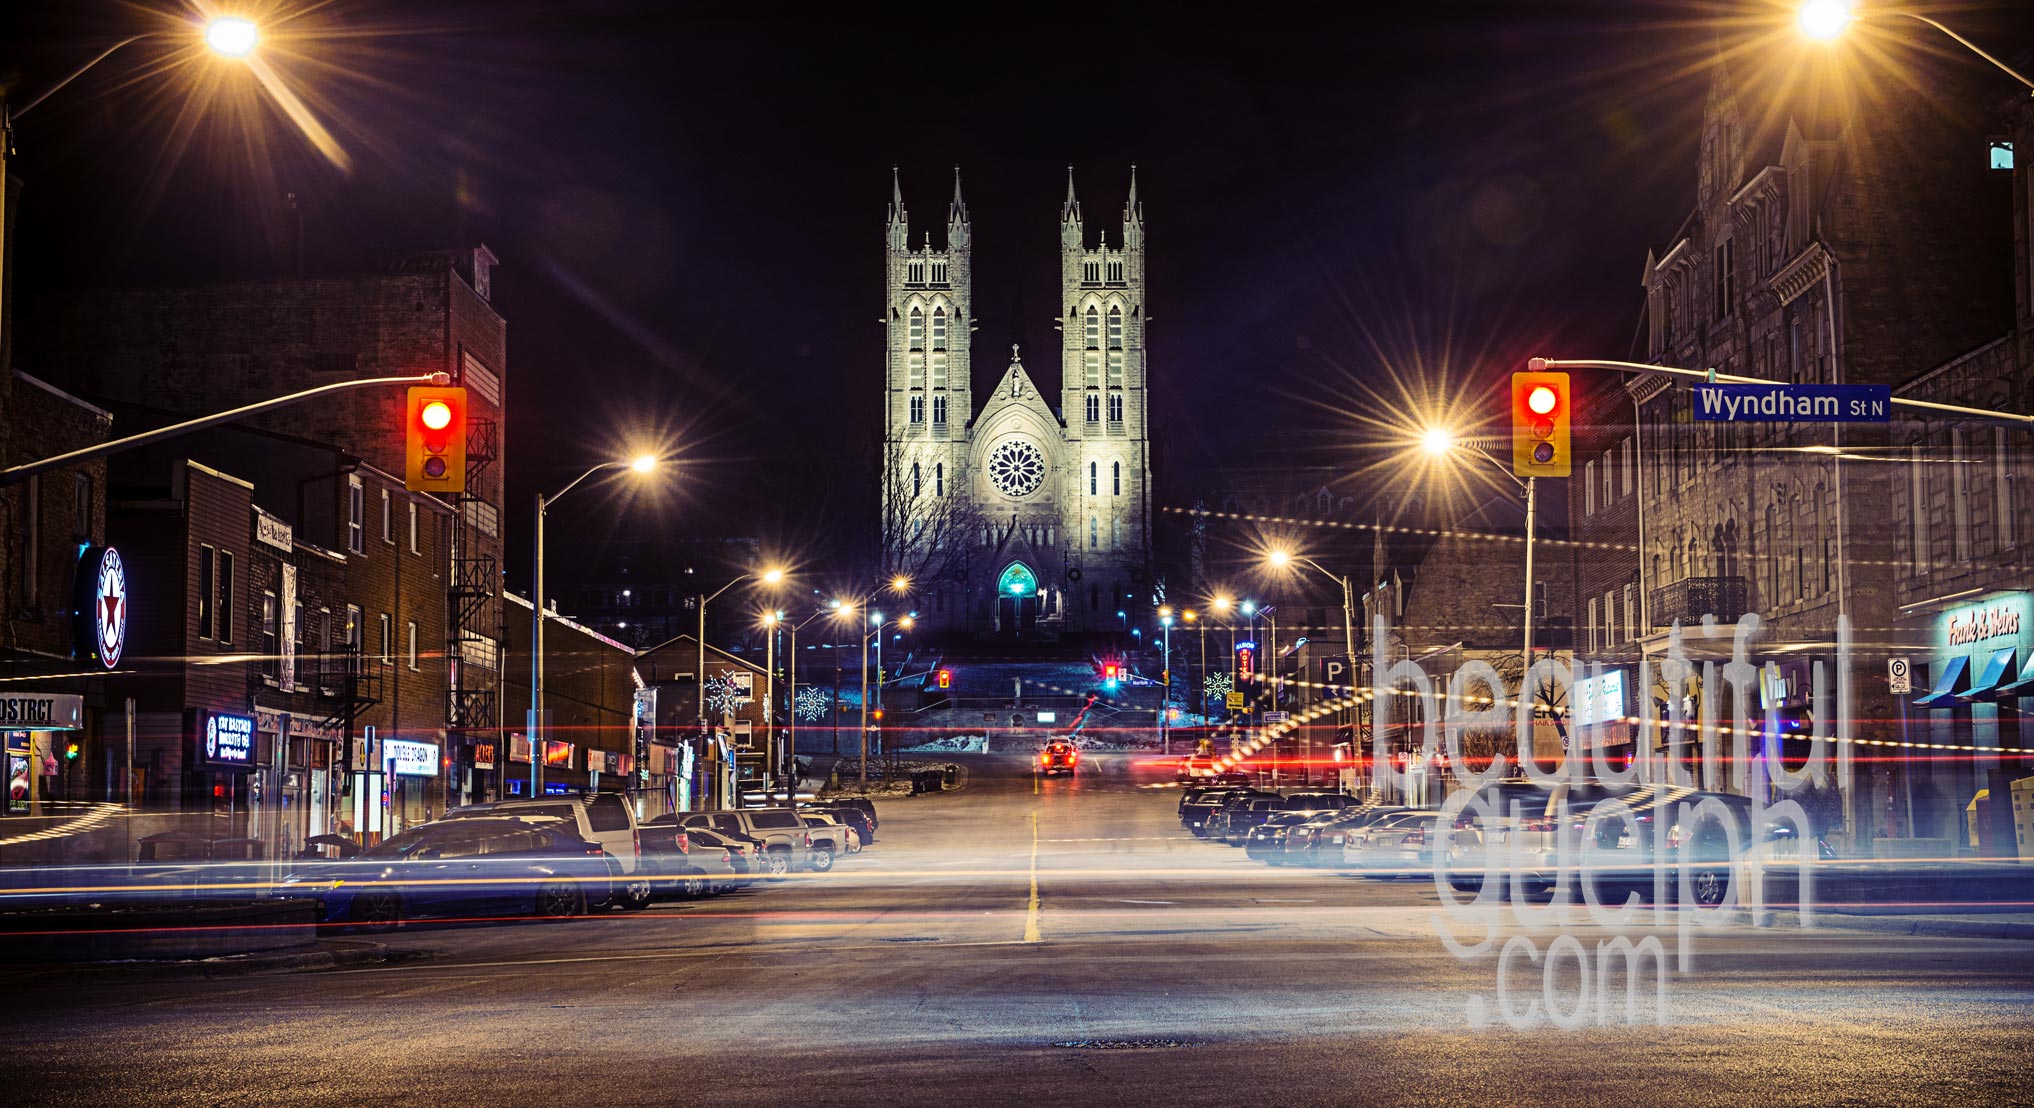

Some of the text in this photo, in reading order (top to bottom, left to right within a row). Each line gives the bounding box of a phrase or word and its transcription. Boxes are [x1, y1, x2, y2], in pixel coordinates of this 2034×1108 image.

[1701, 388, 1883, 420] Wyndham St N
[1948, 605, 2019, 646] Frank & Steins
[1236, 642, 1254, 650] ALBION
[1327, 661, 1343, 682] P
